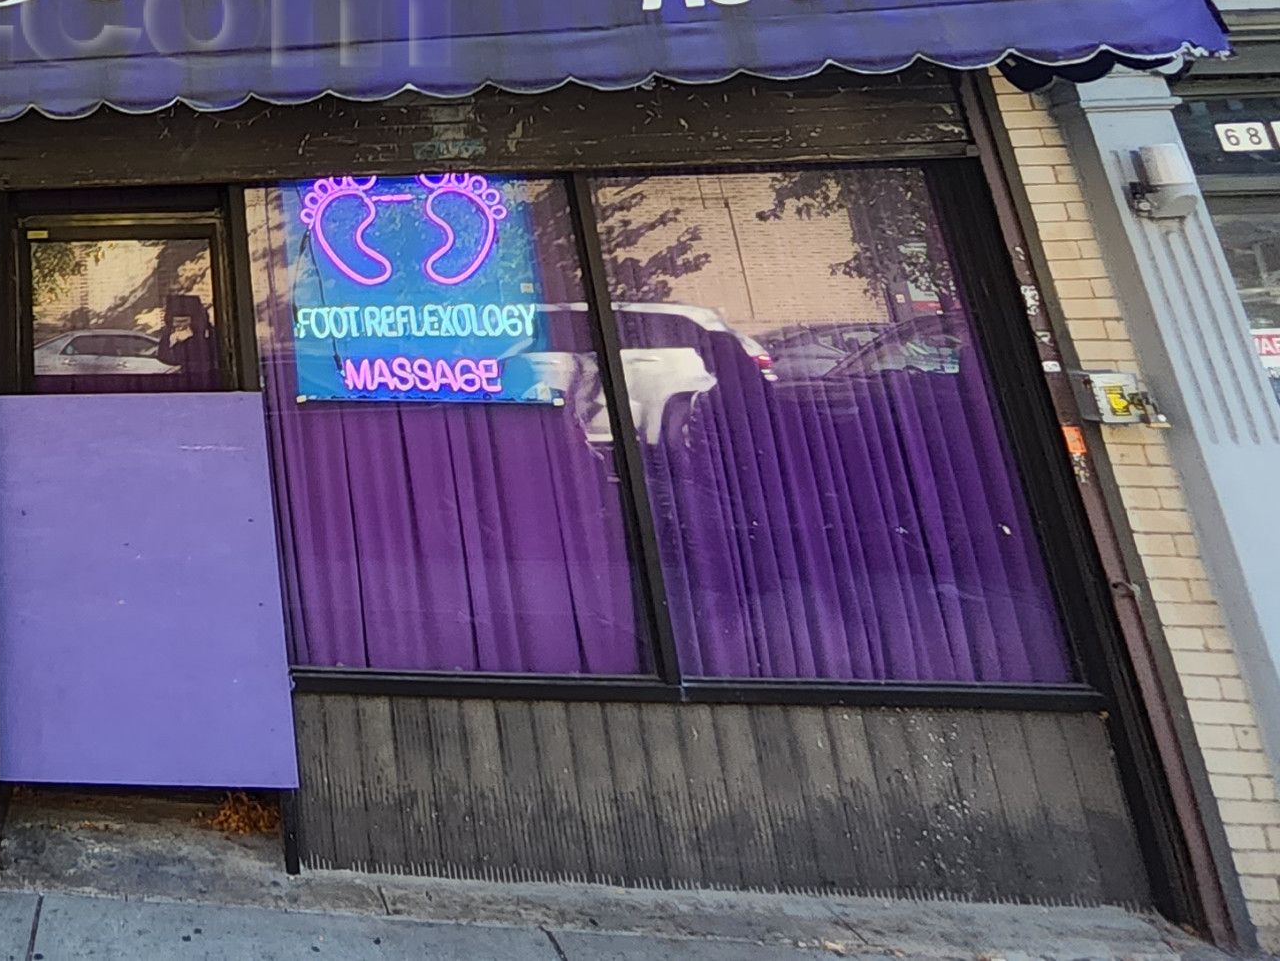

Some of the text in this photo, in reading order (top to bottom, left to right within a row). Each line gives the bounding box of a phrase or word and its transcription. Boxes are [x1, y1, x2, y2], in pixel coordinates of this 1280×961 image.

[1225, 127, 1262, 146] 68
[297, 303, 536, 339] FOOT REFLEXOLOGY
[345, 357, 503, 392] MASSAGE
